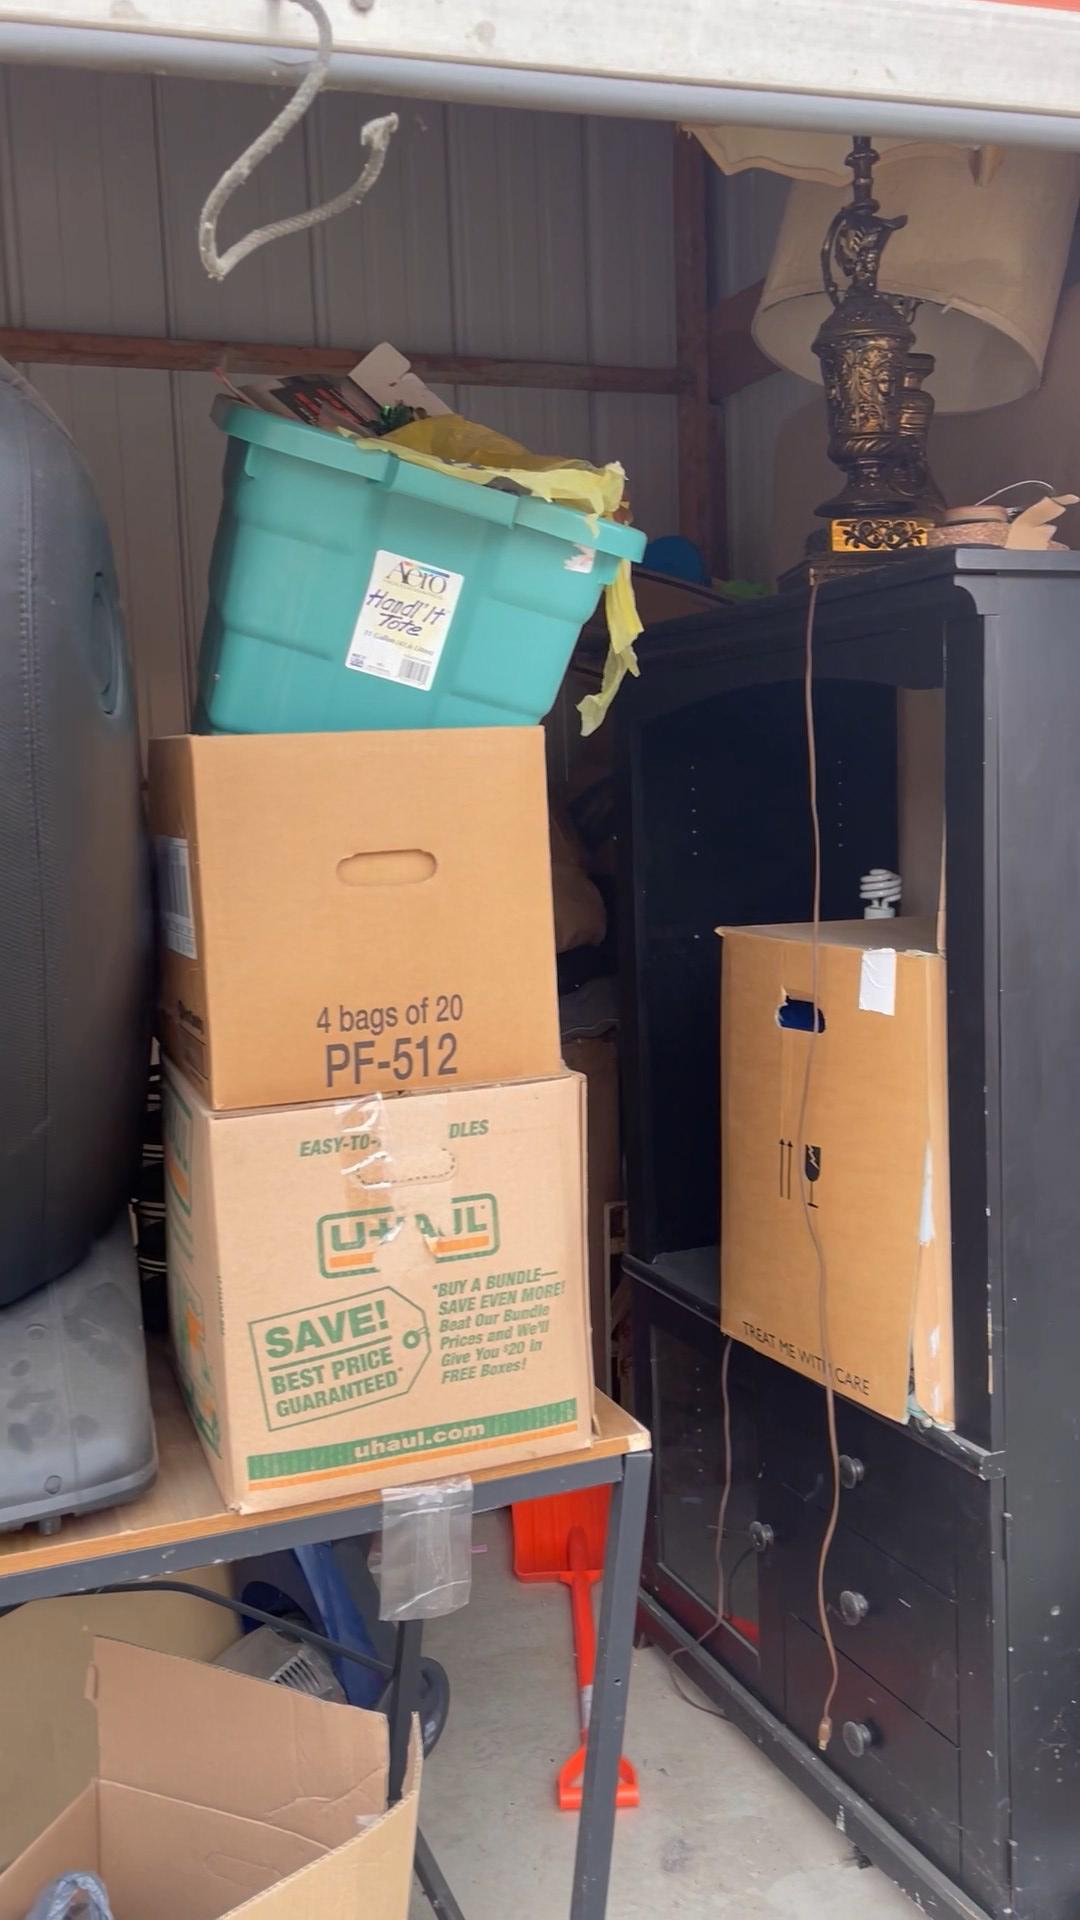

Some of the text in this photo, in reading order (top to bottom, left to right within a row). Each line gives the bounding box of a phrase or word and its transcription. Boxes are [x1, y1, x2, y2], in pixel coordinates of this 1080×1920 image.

[385, 561, 447, 594] Aero
[379, 612, 423, 637] Tote
[316, 994, 464, 1036] 4 bags of 20
[325, 1032, 459, 1088] PF-512
[299, 1119, 490, 1157] EASY-TO- DLES
[438, 1280, 566, 1316] SAVE EVEN MORE!
[470, 1278, 481, 1292] A
[265, 1300, 389, 1358] SAVE!
[438, 1303, 551, 1333] Beat Our Bundle
[439, 1319, 550, 1350] Prices and We'll
[440, 1338, 544, 1367] Give You $20 in
[742, 1320, 776, 1349] TREAT
[778, 1338, 797, 1360] ME
[834, 1366, 871, 1397] CARE
[271, 1346, 394, 1396] BEST PRICE
[441, 1357, 528, 1385] FREE Boxes!
[353, 1421, 486, 1460] uhaul.com
